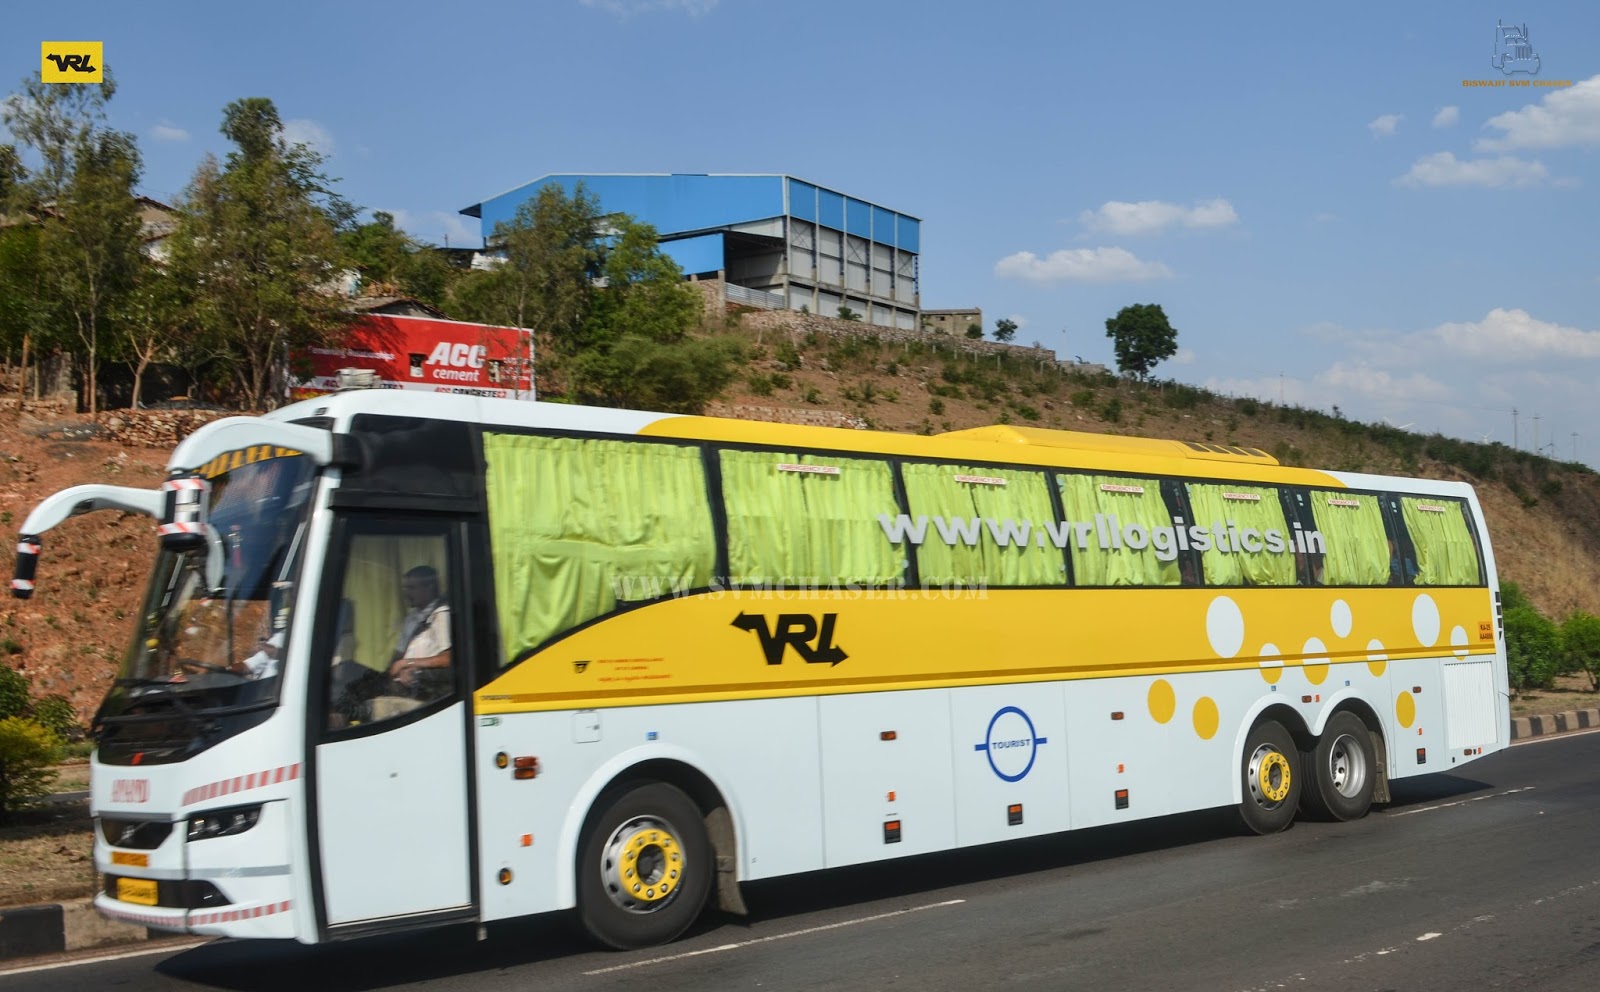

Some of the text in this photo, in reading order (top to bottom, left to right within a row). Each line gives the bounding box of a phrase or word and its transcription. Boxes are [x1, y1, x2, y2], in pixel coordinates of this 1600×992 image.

[425, 341, 487, 369] ACC
[432, 368, 480, 382] cement
[878, 513, 1326, 562] www.vrllogistics.in
[729, 610, 849, 667] VRL
[991, 738, 1031, 750] TOURIST
